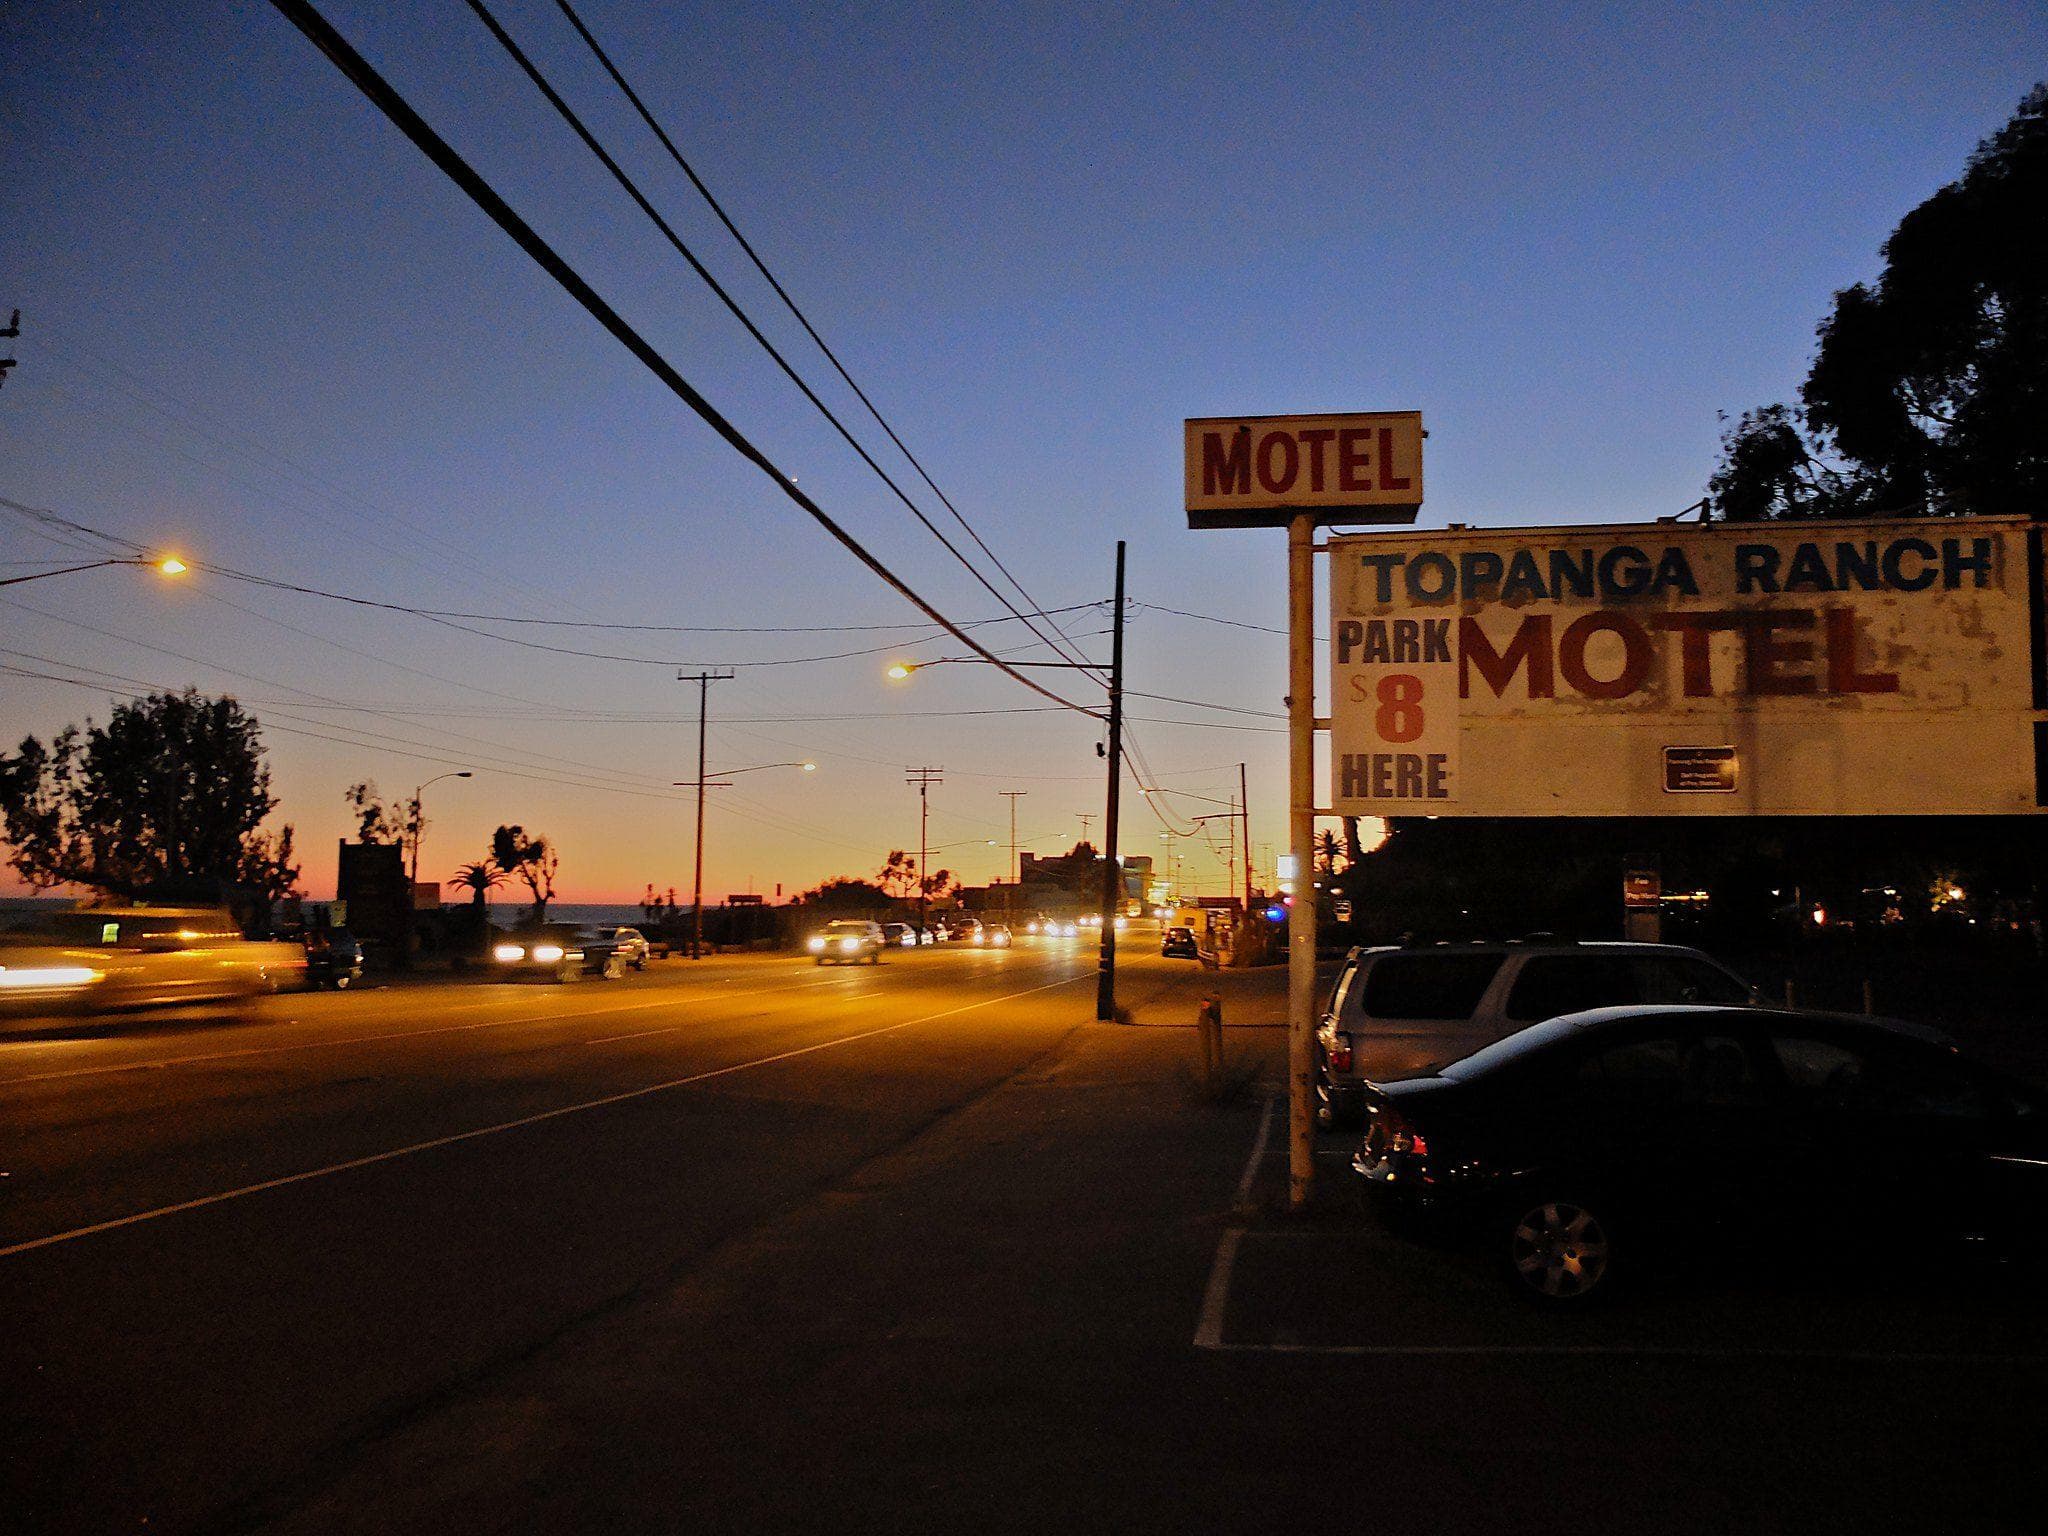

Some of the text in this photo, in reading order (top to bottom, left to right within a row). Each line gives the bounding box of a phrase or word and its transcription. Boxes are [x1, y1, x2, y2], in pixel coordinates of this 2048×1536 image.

[1203, 427, 1411, 495] MOTEL
[1361, 537, 1992, 603] TOPANGA RANCH
[1338, 618, 1452, 664] PARK
[1458, 608, 1899, 699] MOTEL
[1341, 753, 1449, 798] HERE
